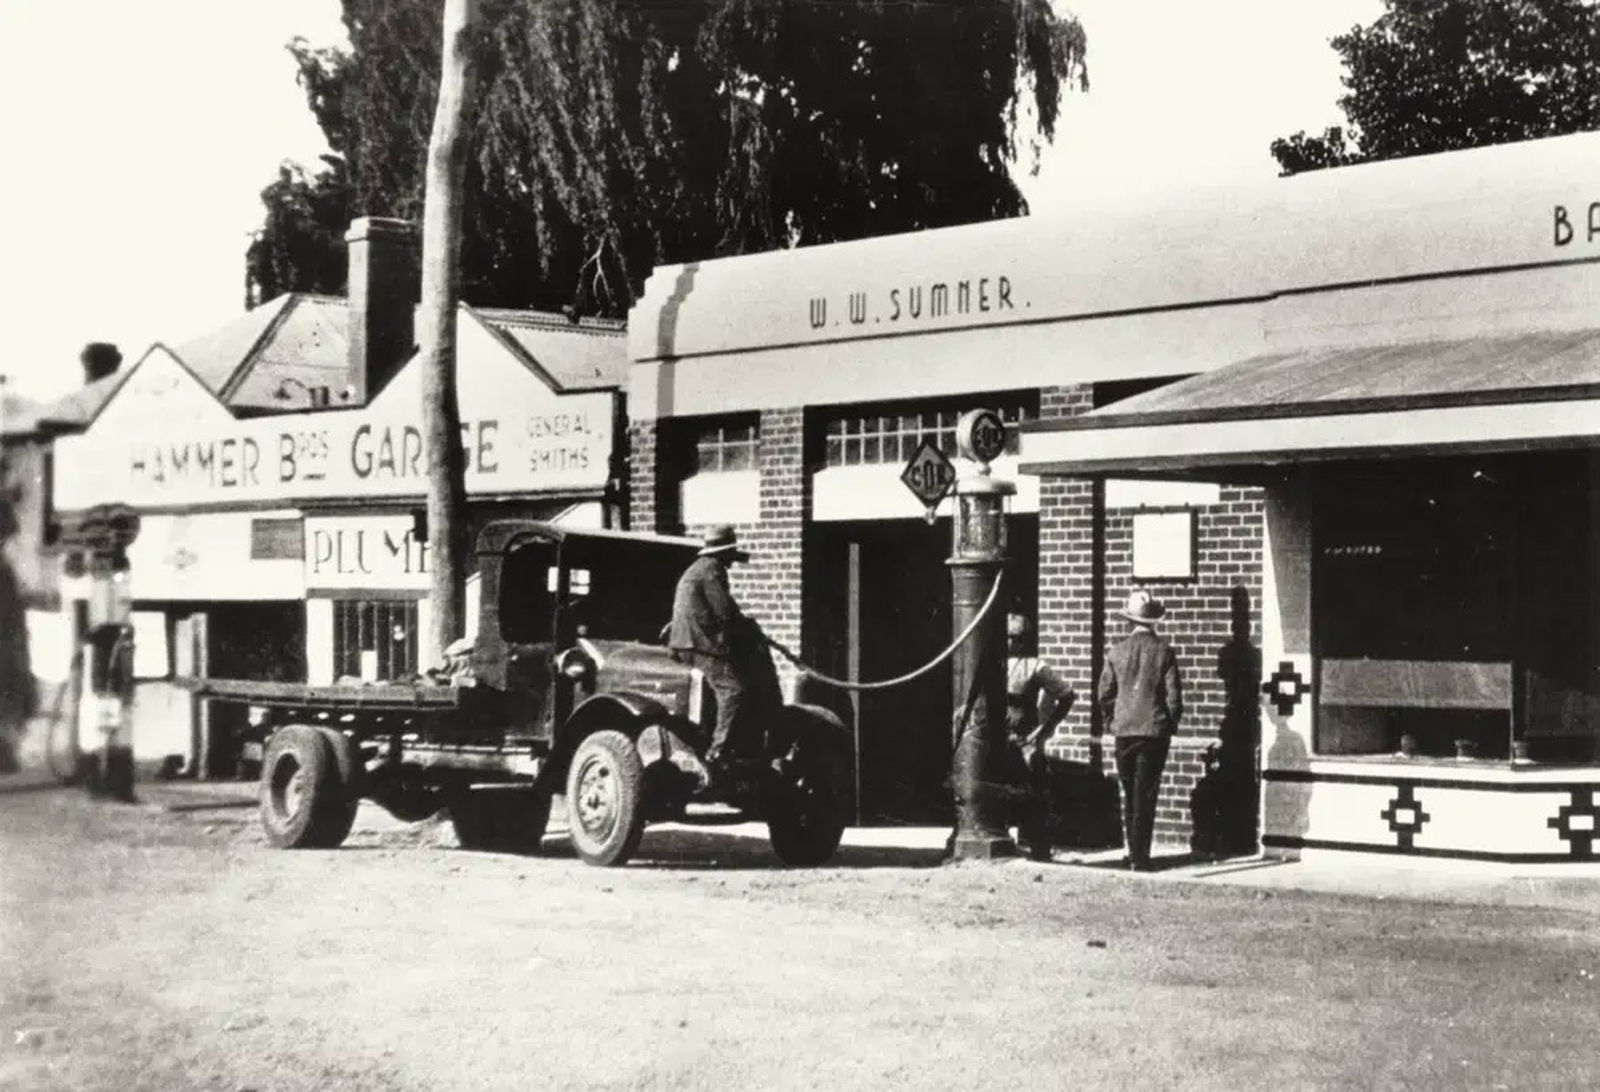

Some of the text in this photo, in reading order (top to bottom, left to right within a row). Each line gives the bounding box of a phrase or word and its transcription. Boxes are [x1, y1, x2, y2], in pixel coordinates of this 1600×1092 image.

[129, 436, 261, 488] HAMMER
[351, 419, 499, 479] GARE
[529, 446, 590, 472] SMITHS
